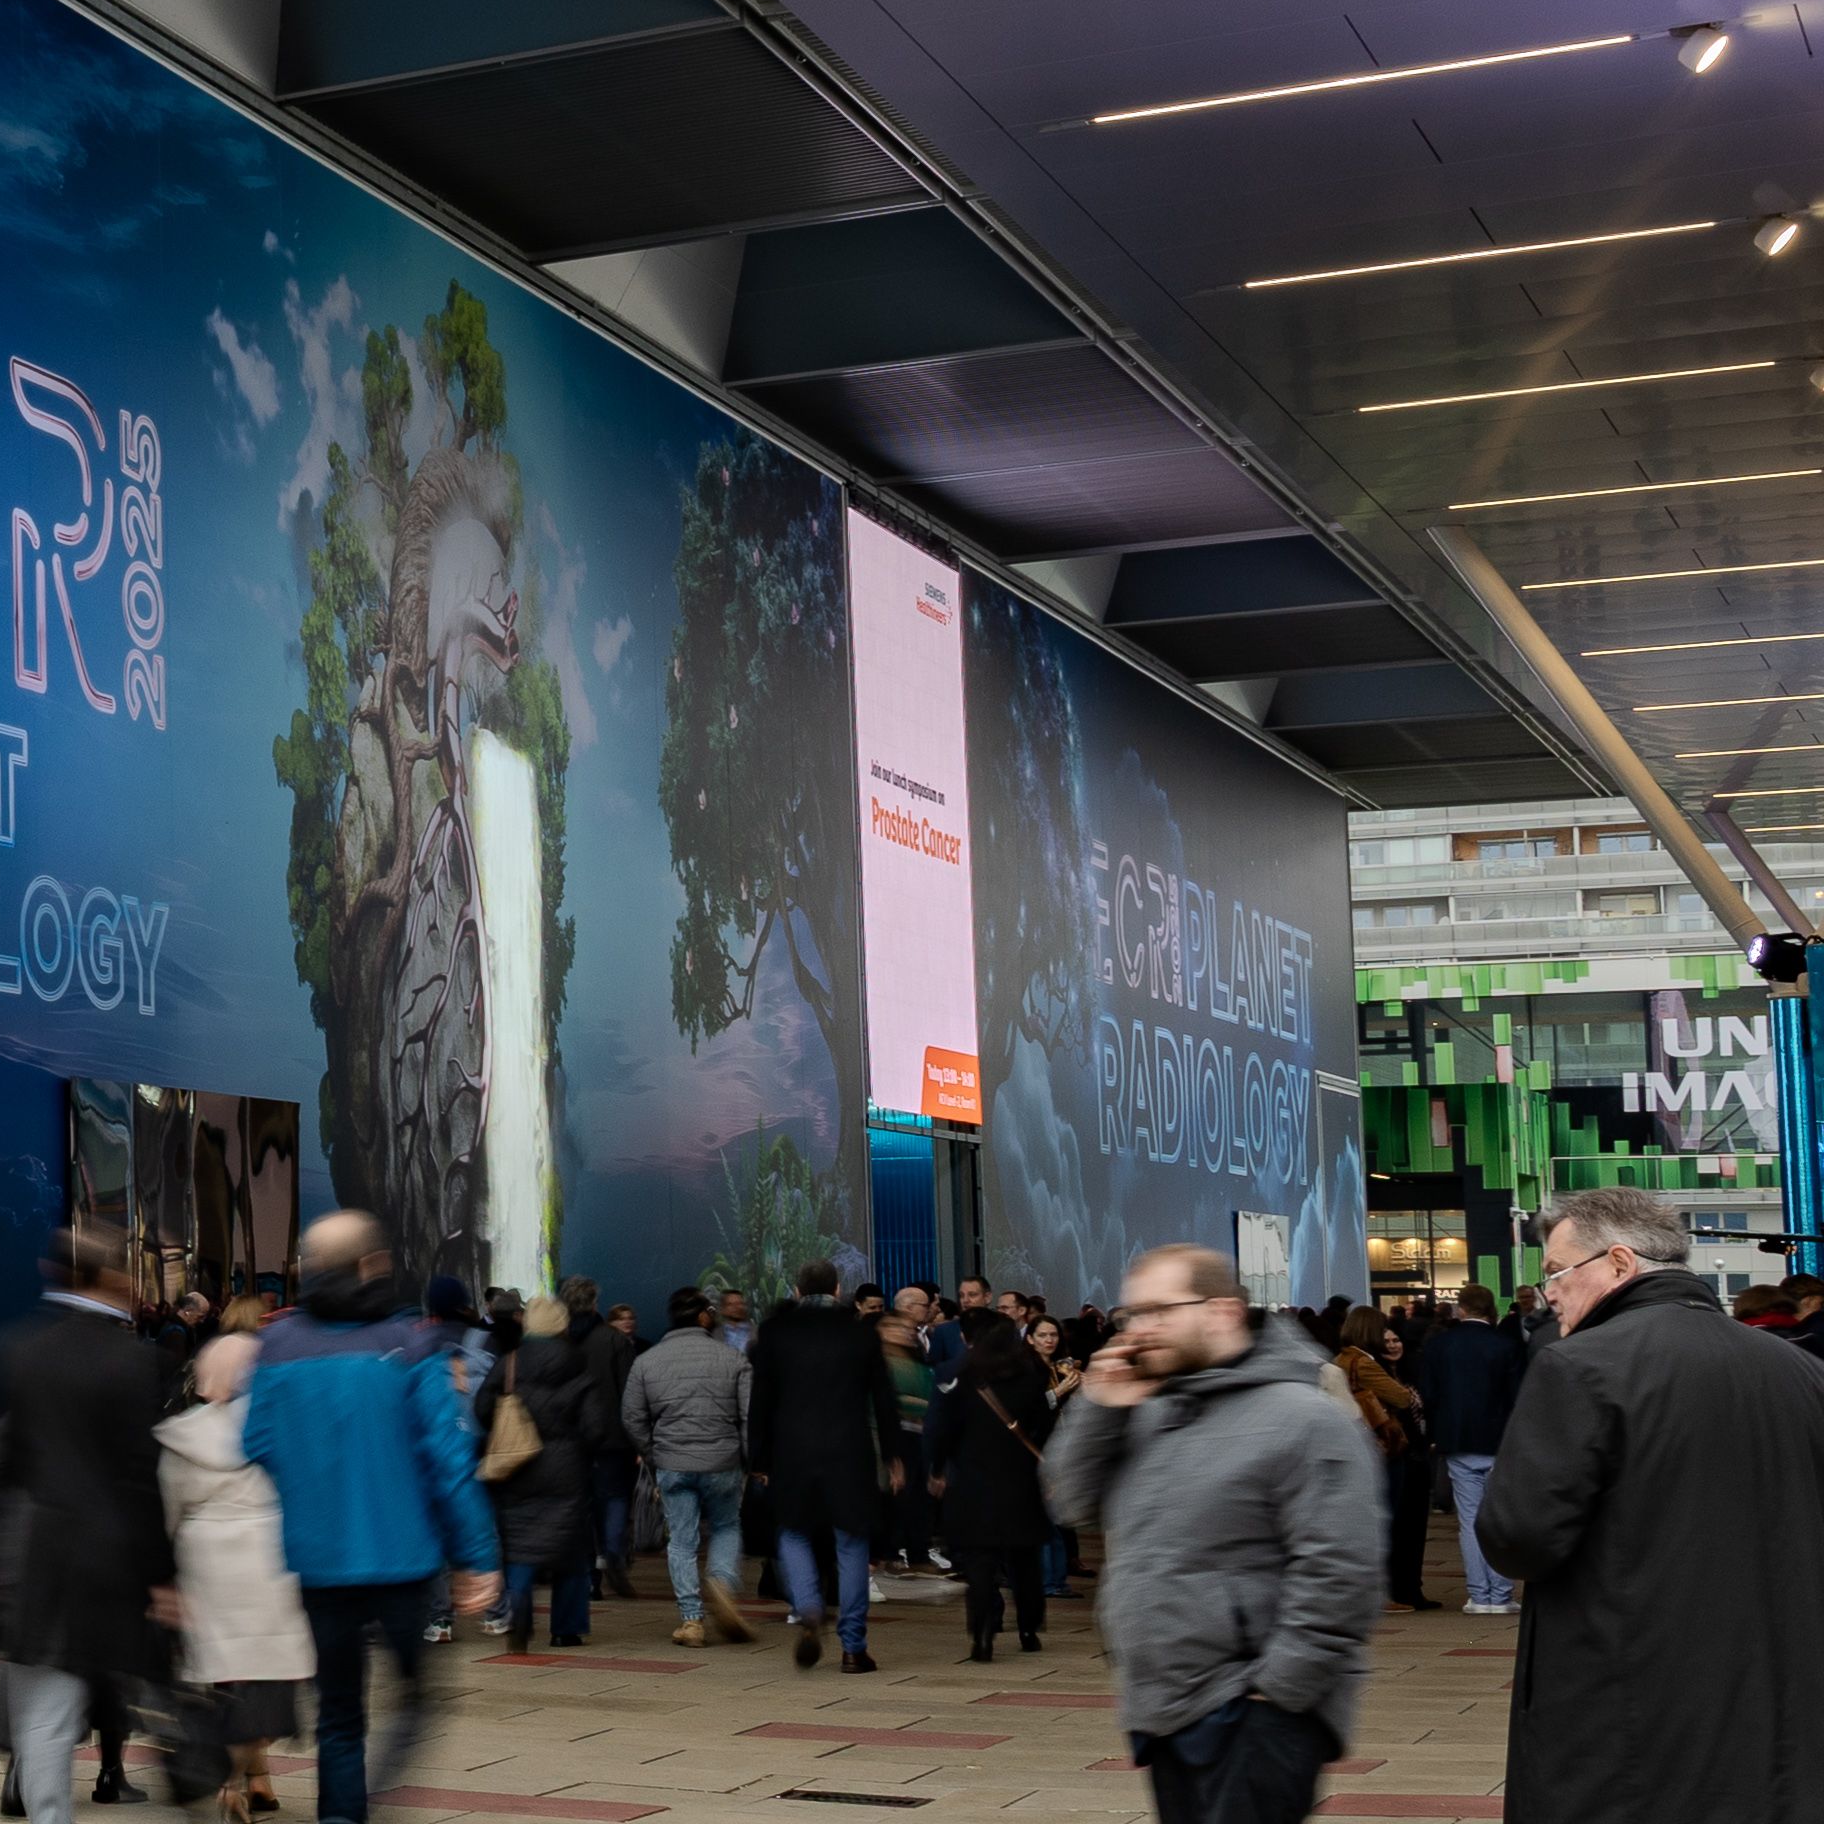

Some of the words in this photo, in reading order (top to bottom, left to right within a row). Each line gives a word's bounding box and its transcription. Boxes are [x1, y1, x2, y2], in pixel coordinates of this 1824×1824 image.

[119, 408, 167, 731] 2025
[871, 795, 920, 852] Prostate
[921, 818, 961, 866] Cancer
[1181, 878, 1313, 1045] PLANET
[1098, 1015, 1311, 1186] RADIOLOGY
